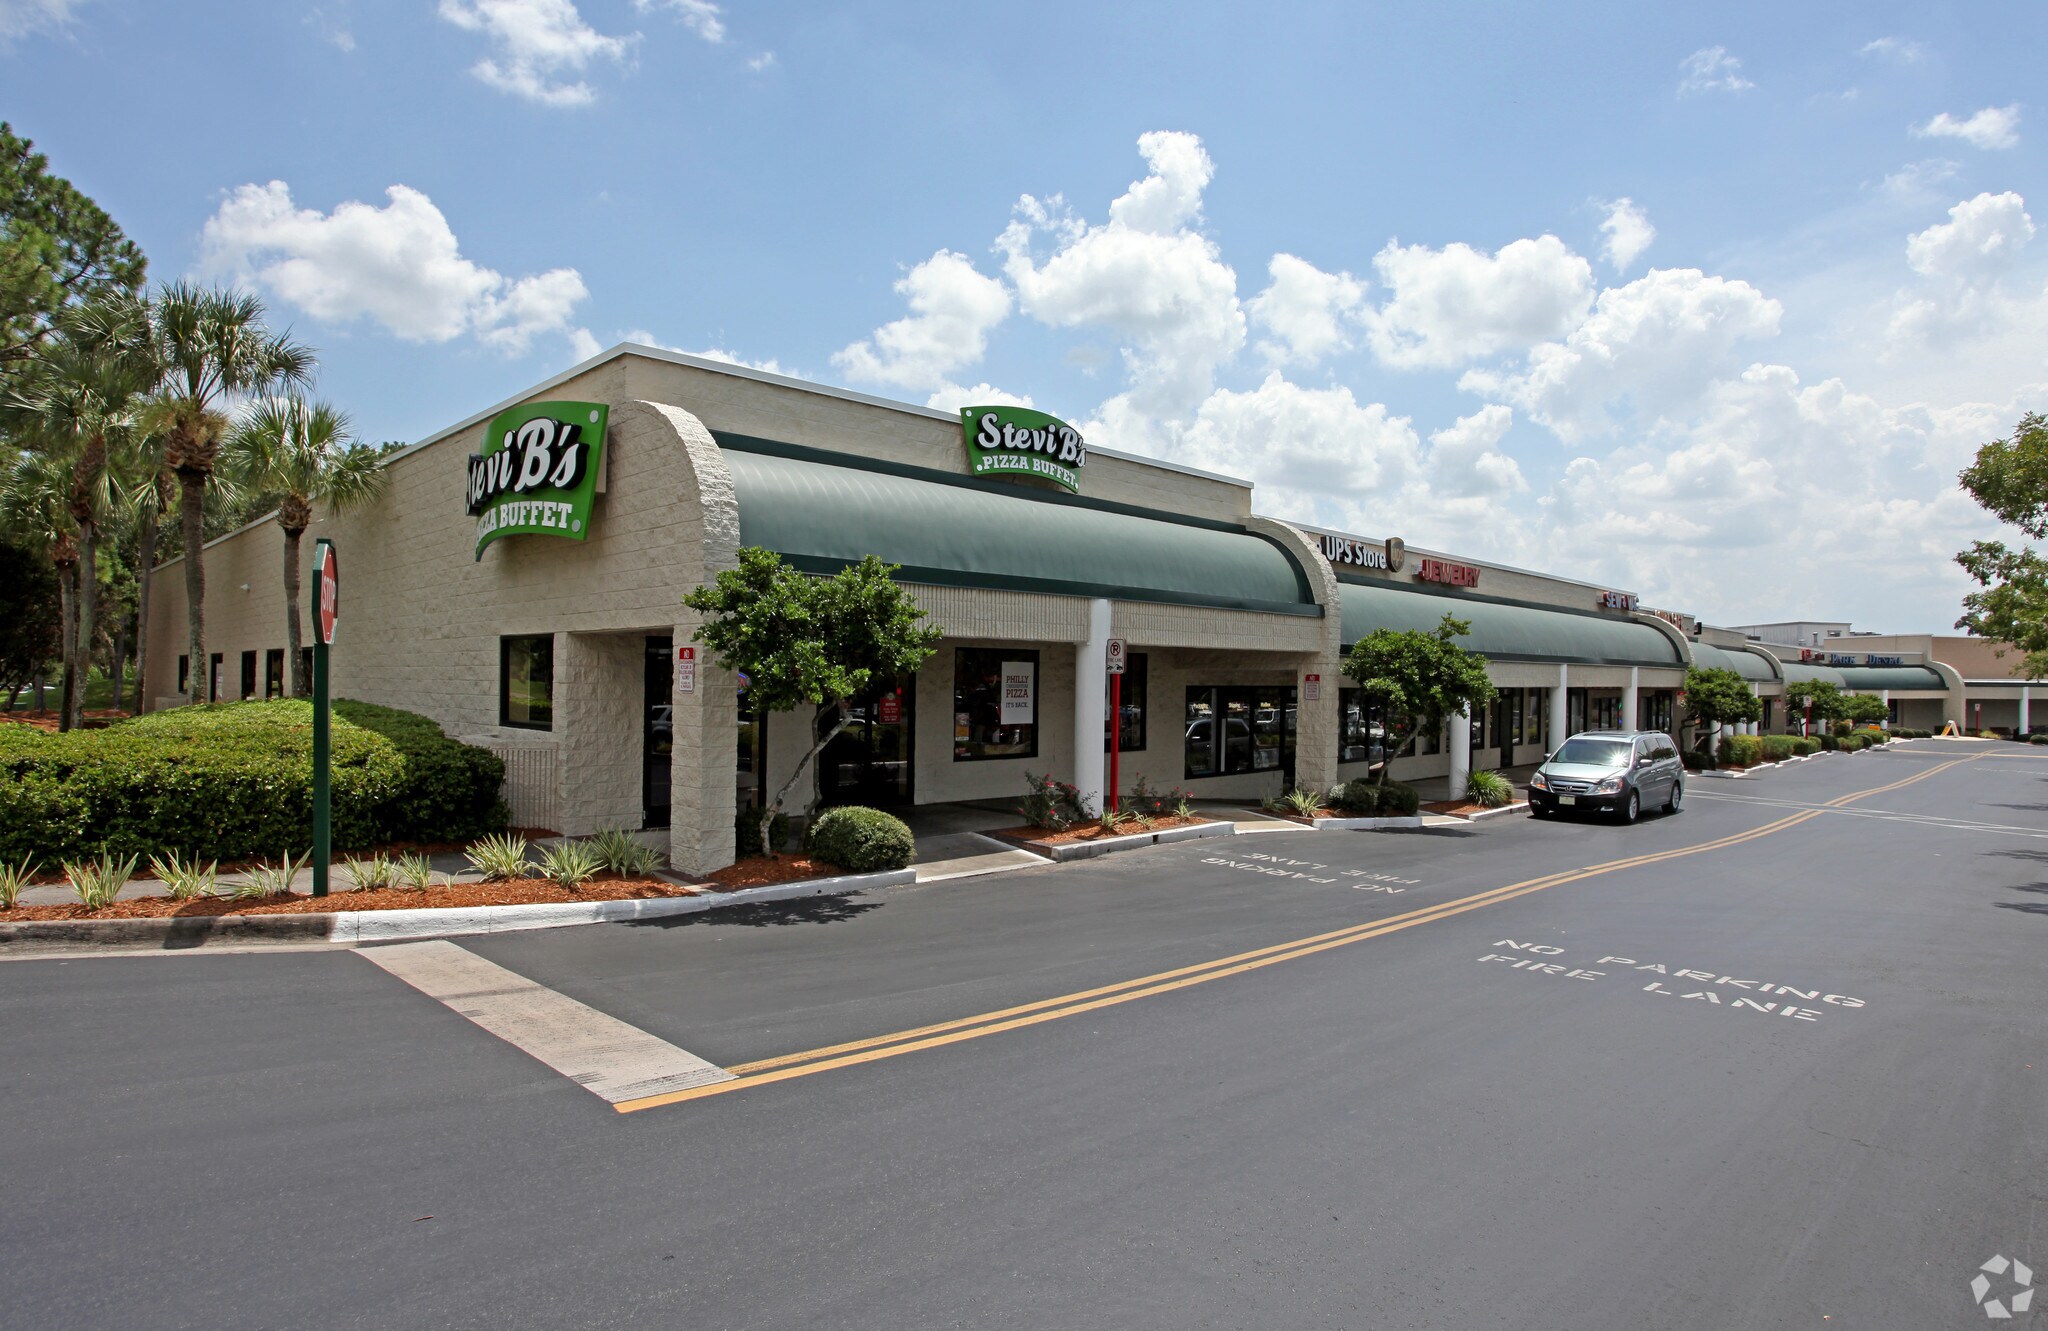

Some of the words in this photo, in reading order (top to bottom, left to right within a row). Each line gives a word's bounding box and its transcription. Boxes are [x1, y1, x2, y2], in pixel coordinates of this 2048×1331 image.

[977, 412, 1058, 454] Stevi
[982, 454, 1029, 470] PIZZA
[1032, 457, 1076, 486] BUFFET
[499, 500, 573, 529] BUFFET
[1325, 535, 1353, 564] UPS
[1355, 542, 1387, 570] Store
[1419, 559, 1481, 588] JEWELRY
[1606, 591, 1622, 608] SEW
[1006, 675, 1029, 684] PHILLY
[1006, 688, 1029, 698] PIZZA
[1201, 857, 1338, 884] PARKING
[1241, 852, 1328, 870] LANE
[1340, 869, 1422, 885] FIRE
[1352, 883, 1406, 894] NO
[1476, 953, 1607, 981] FIRE
[1642, 981, 1823, 1022] LANE
[1492, 938, 1566, 956] NO
[1595, 955, 1867, 1009] PARKING
